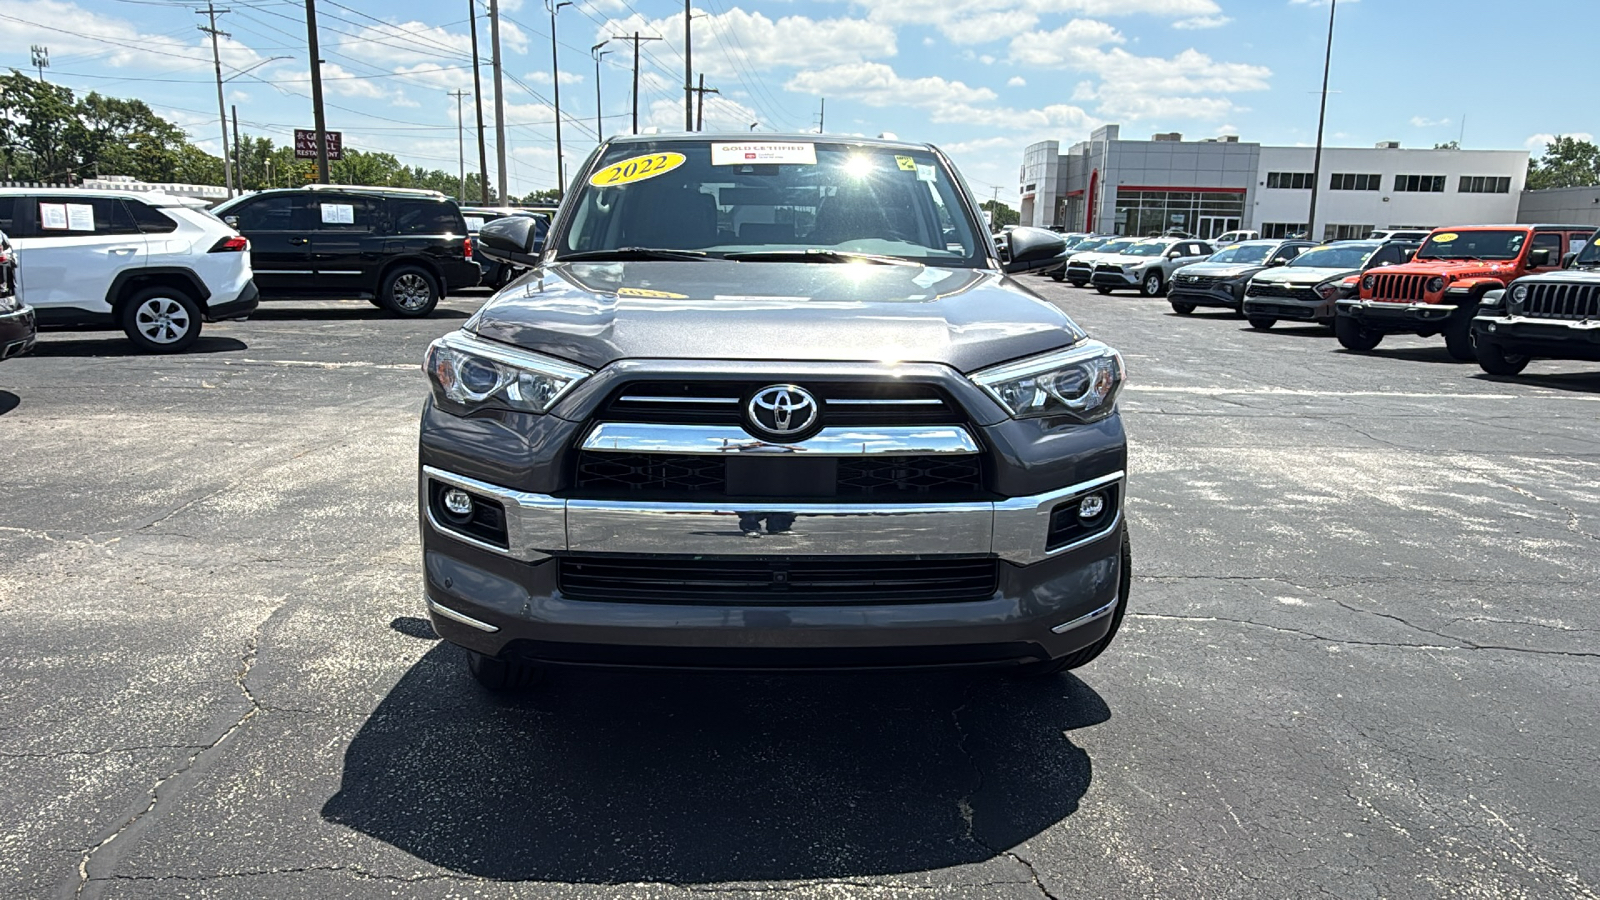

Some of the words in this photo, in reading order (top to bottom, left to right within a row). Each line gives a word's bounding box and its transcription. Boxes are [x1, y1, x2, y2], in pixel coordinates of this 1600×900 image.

[307, 132, 337, 141] GAT
[307, 142, 336, 150] WLL
[607, 155, 668, 183] 2022
